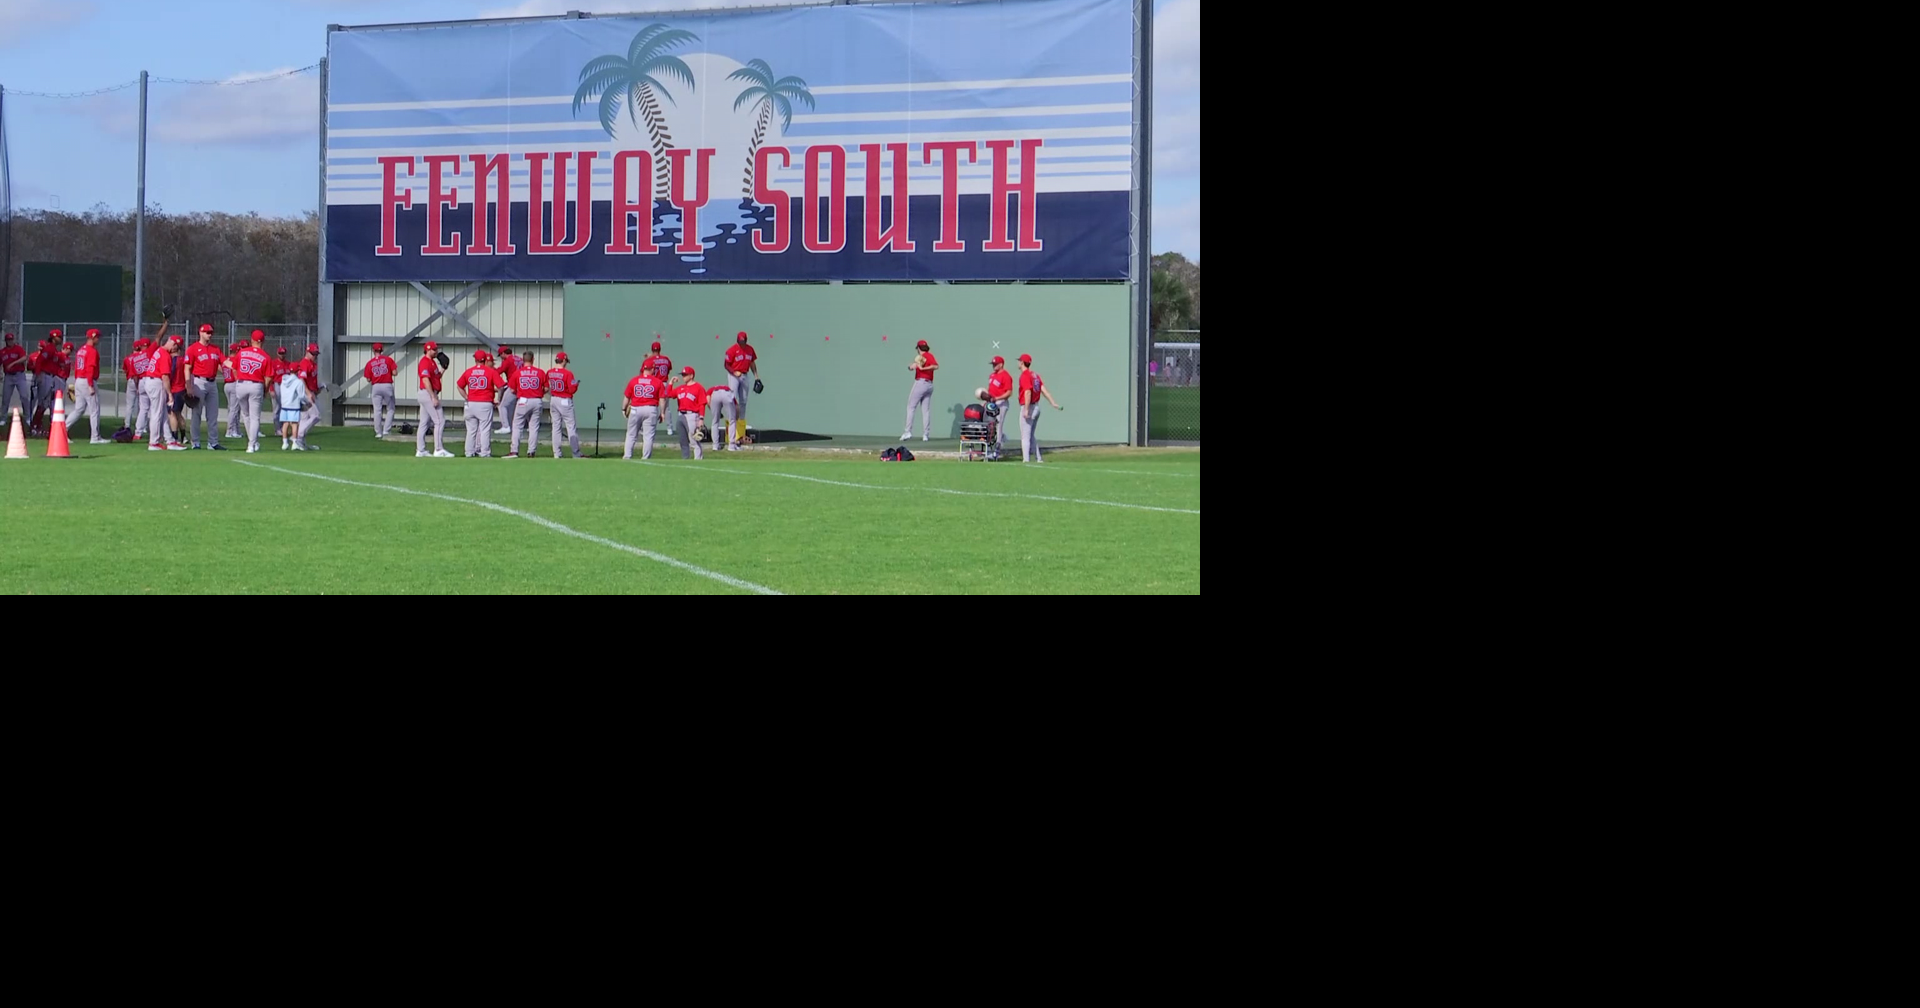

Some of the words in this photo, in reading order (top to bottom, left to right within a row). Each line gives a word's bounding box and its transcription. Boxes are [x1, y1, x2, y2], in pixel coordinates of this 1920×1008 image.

[375, 148, 717, 257] FENWAY
[751, 139, 1044, 252] SOUTH
[240, 359, 262, 374] 57
[468, 376, 488, 389] 20
[520, 377, 540, 389] 53
[634, 385, 655, 398] 82
